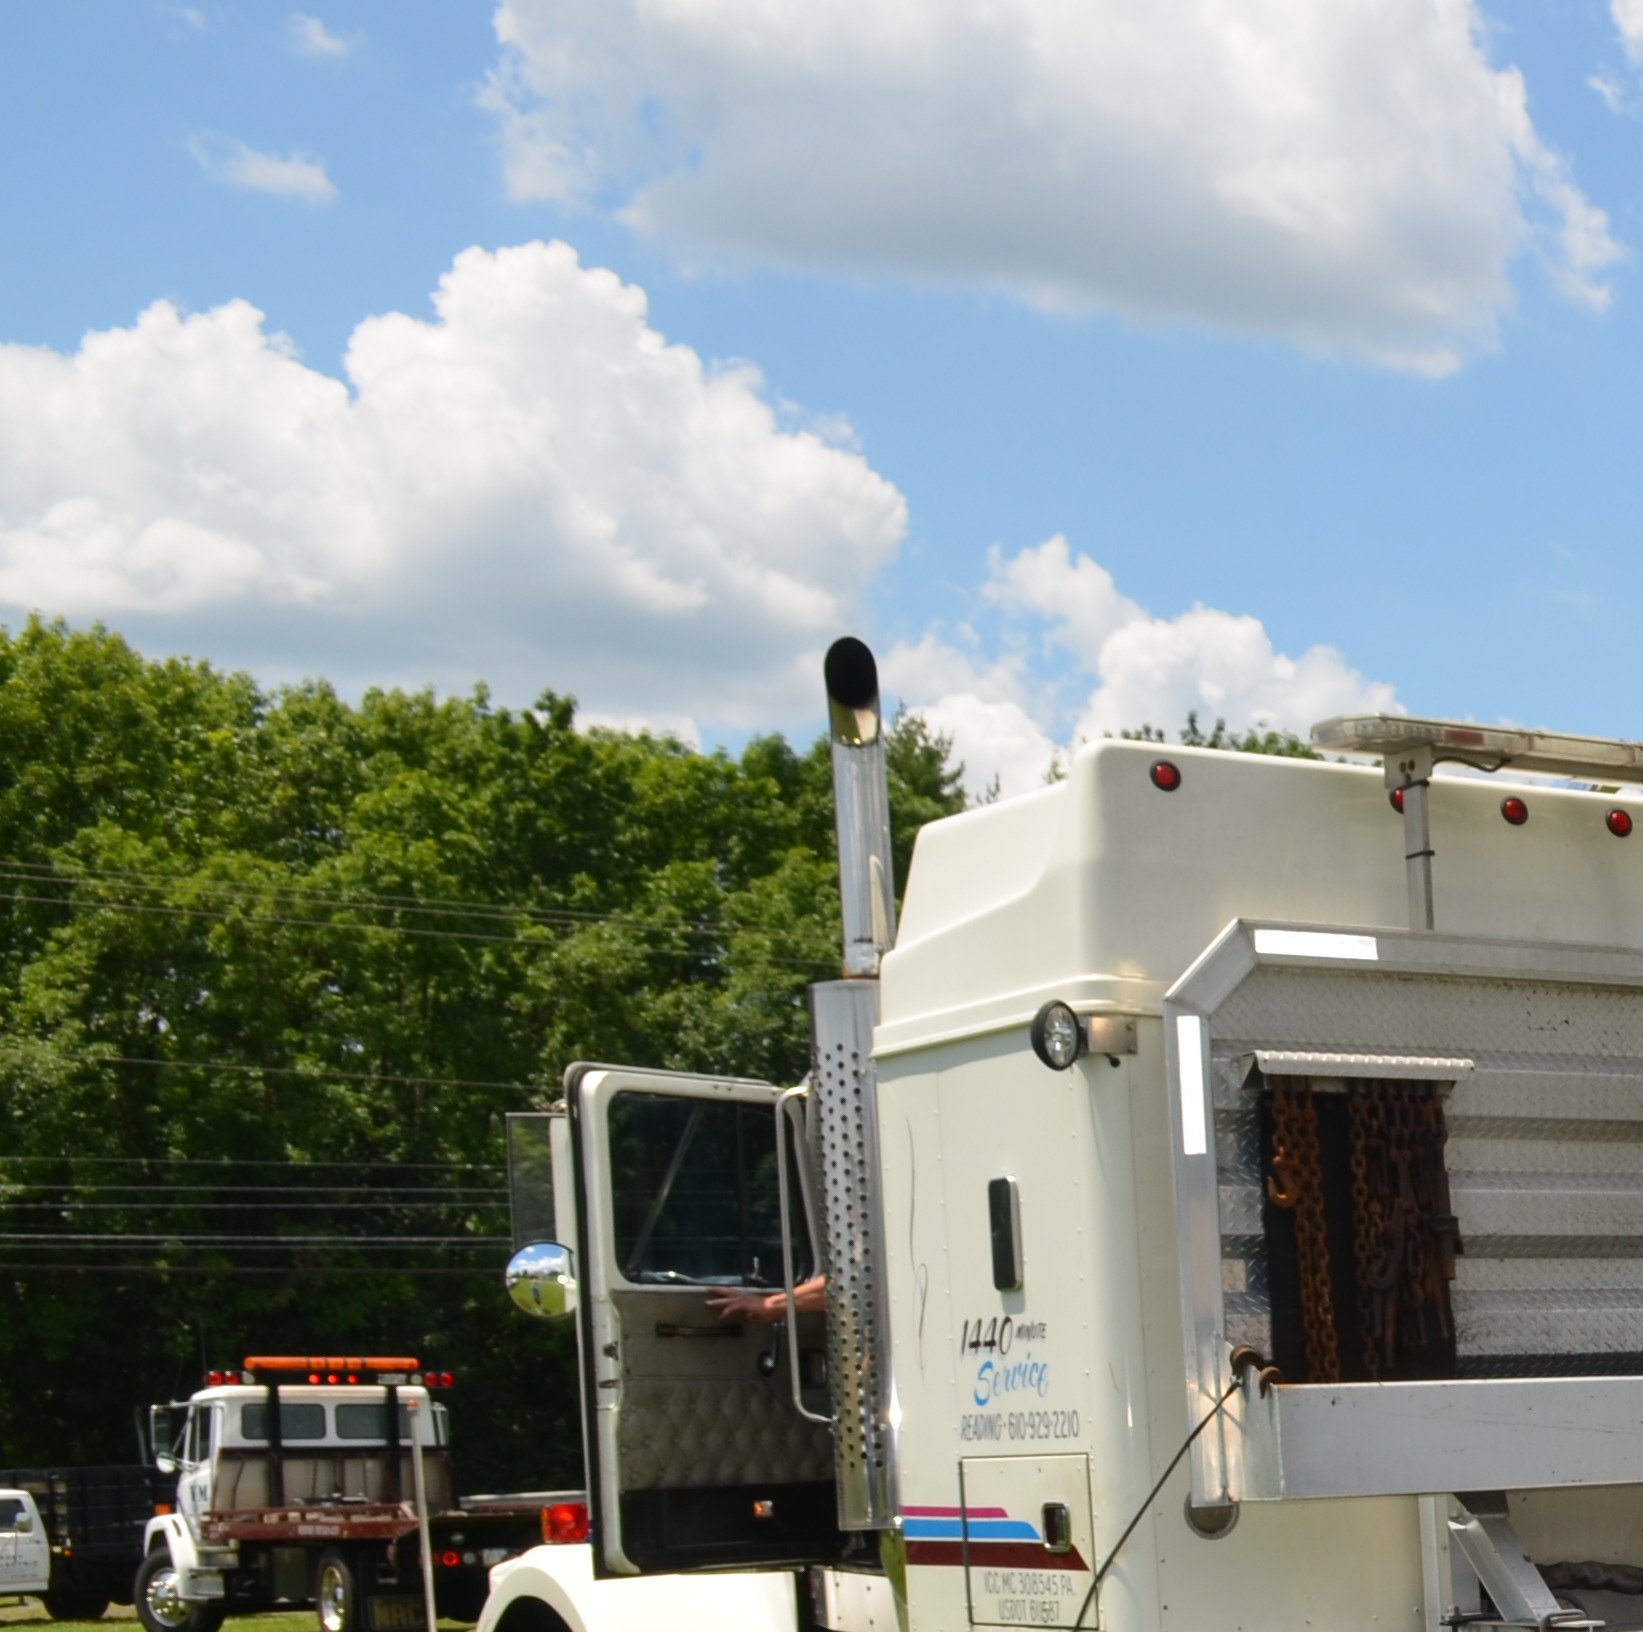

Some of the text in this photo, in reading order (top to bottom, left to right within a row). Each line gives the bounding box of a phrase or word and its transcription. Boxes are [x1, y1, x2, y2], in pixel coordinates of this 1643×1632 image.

[961, 1316, 1014, 1355] 1440
[973, 1352, 1048, 1407] Service
[961, 1412, 1002, 1441] READING
